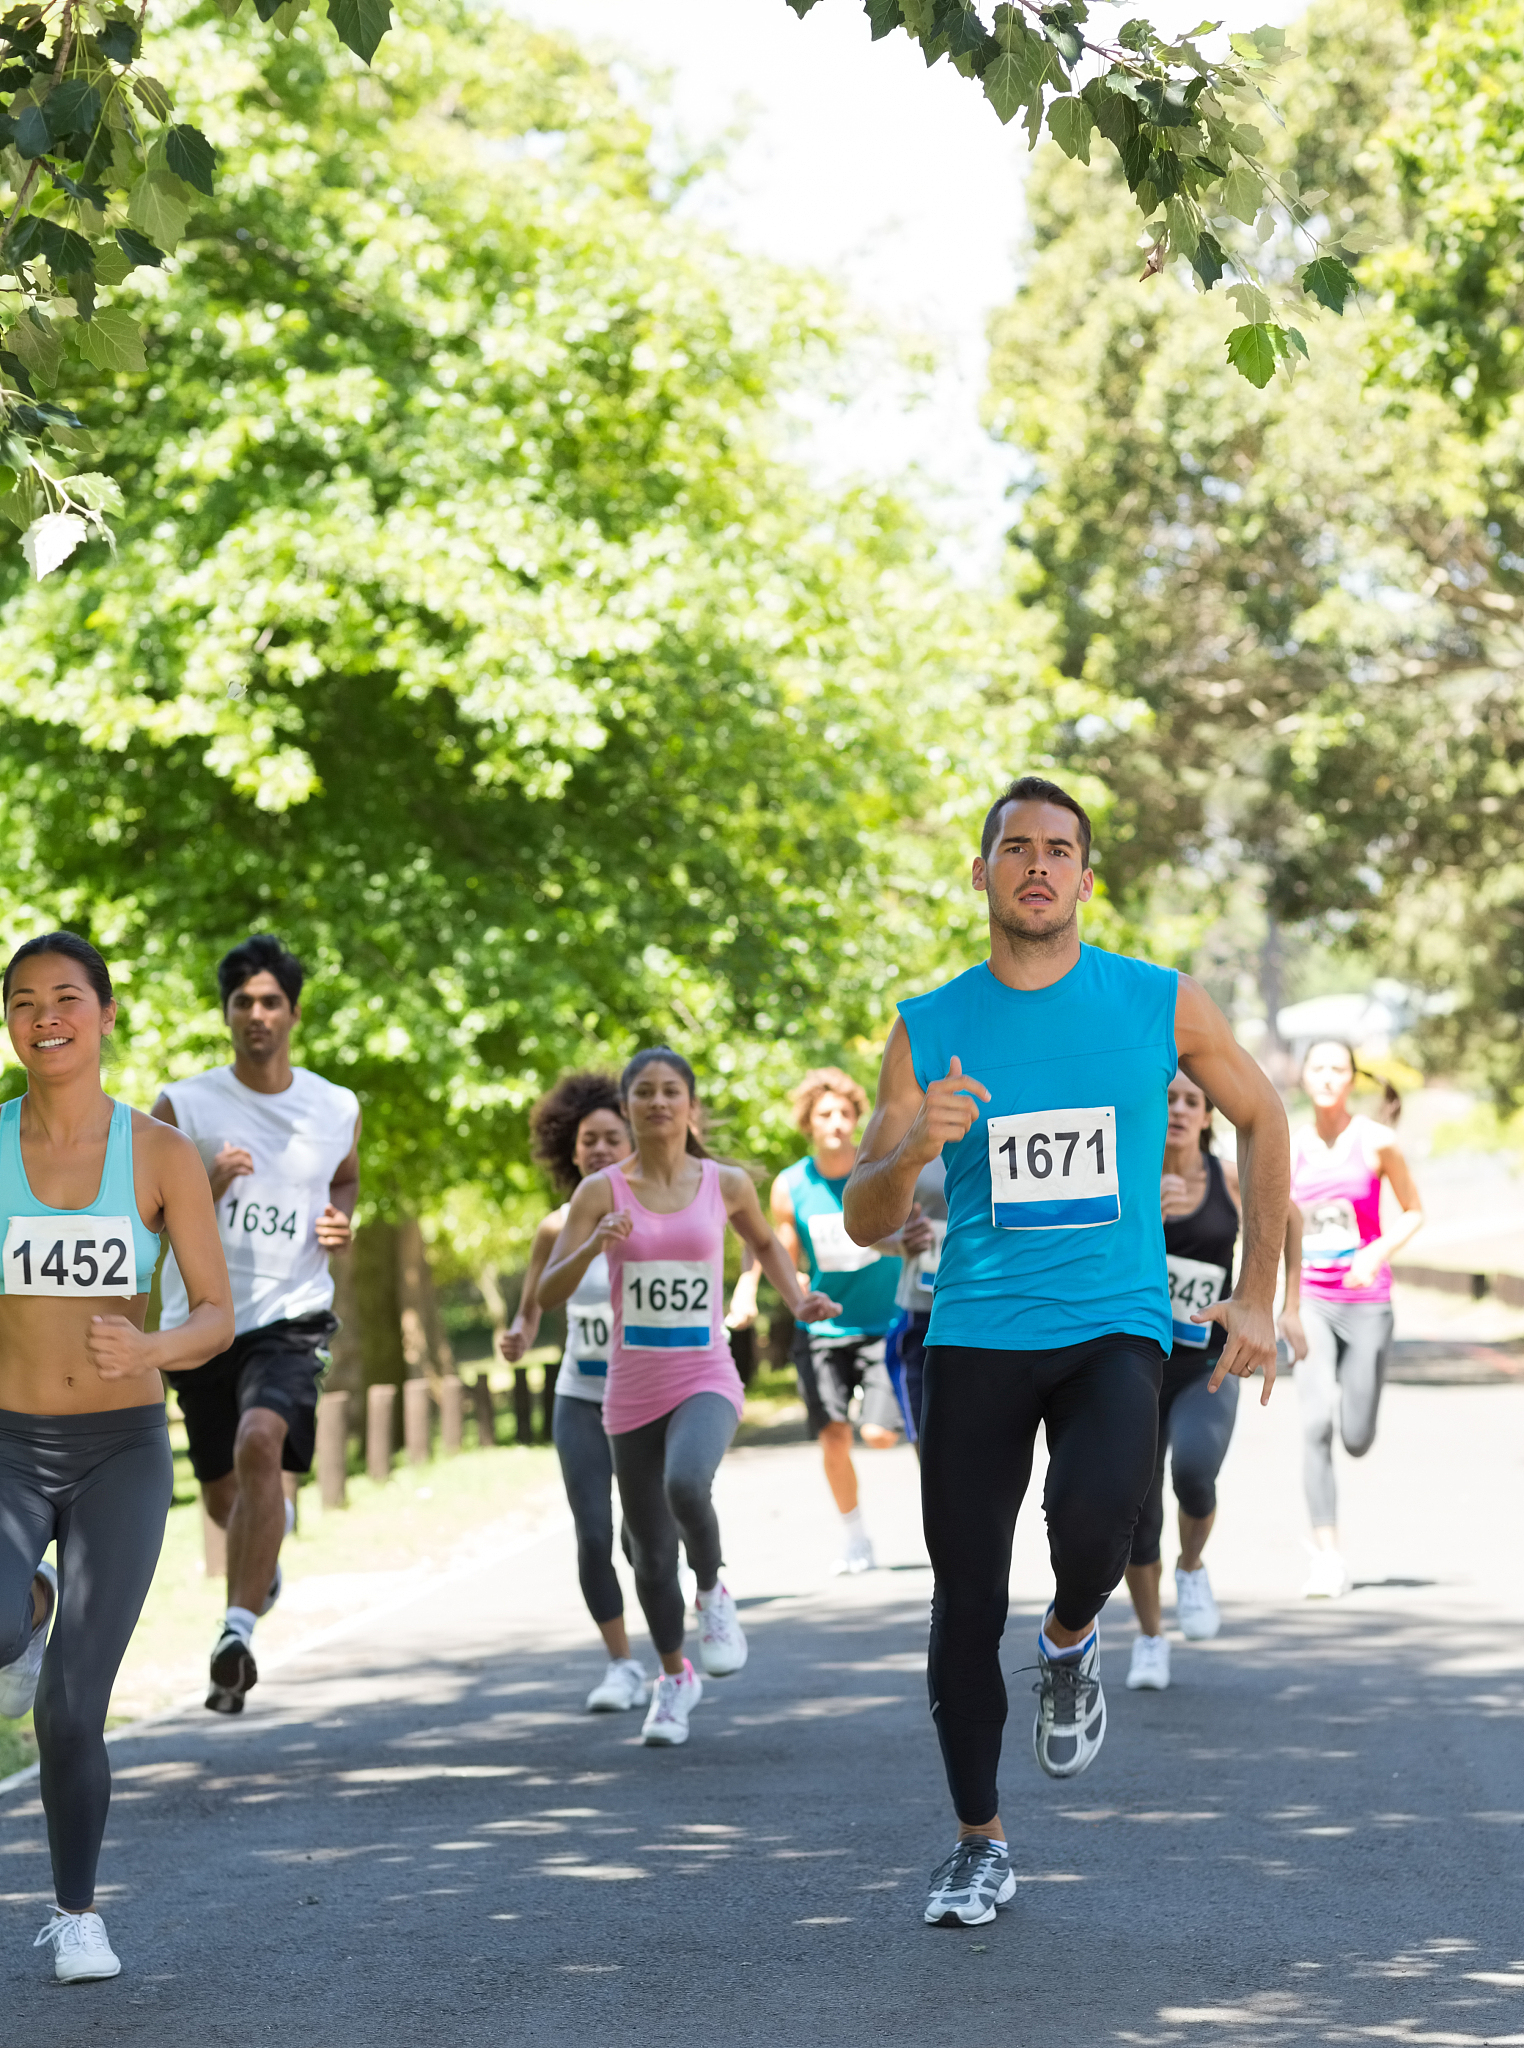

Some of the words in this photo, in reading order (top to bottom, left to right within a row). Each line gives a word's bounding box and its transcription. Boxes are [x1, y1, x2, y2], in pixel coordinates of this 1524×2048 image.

[998, 1129, 1106, 1180] 1671
[226, 1198, 297, 1241] 1634
[12, 1237, 129, 1288] 1452
[629, 1276, 709, 1312] 1652
